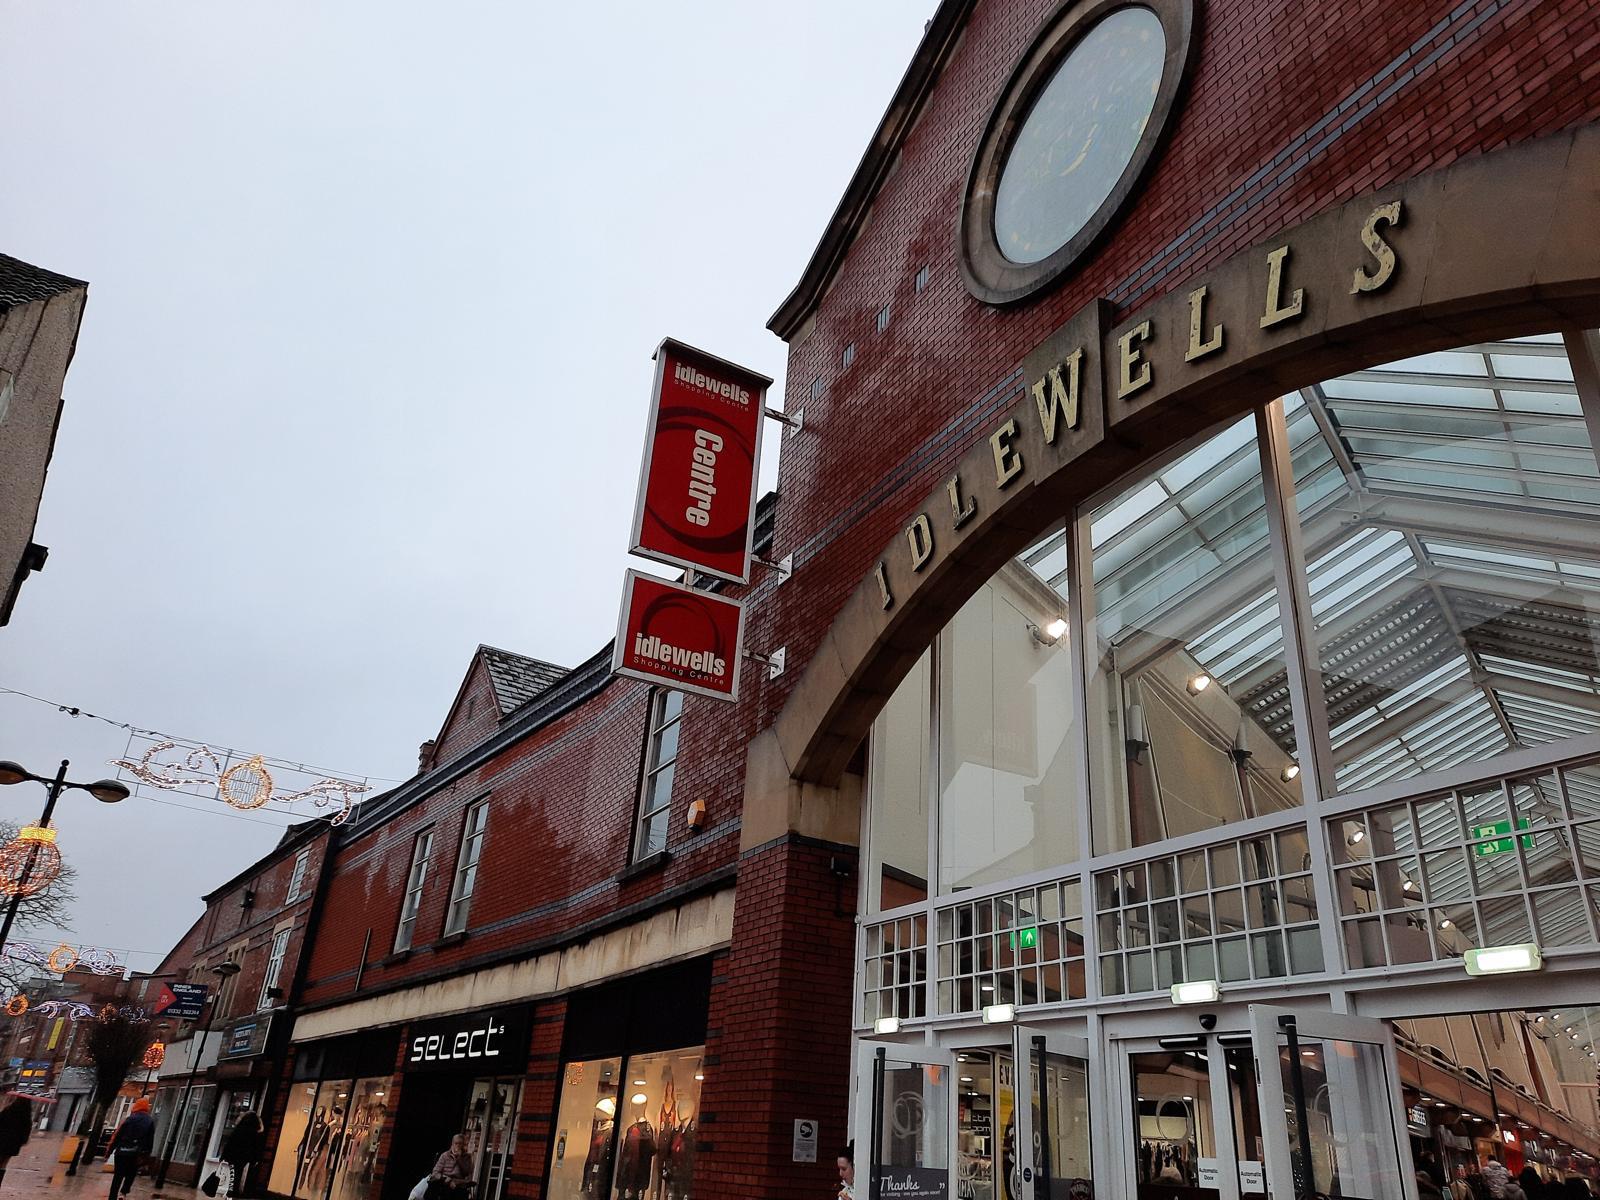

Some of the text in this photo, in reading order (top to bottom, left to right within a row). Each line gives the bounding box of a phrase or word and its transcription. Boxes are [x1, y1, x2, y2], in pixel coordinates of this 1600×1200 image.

[674, 379, 749, 411] Shopping Centre
[675, 362, 749, 405] idlewells
[873, 200, 1402, 610] IDLEWELLS
[686, 429, 723, 527] Centre
[633, 656, 724, 685] Shopping Centre
[634, 632, 726, 676] idlewells
[880, 1174, 920, 1191] Thanks
